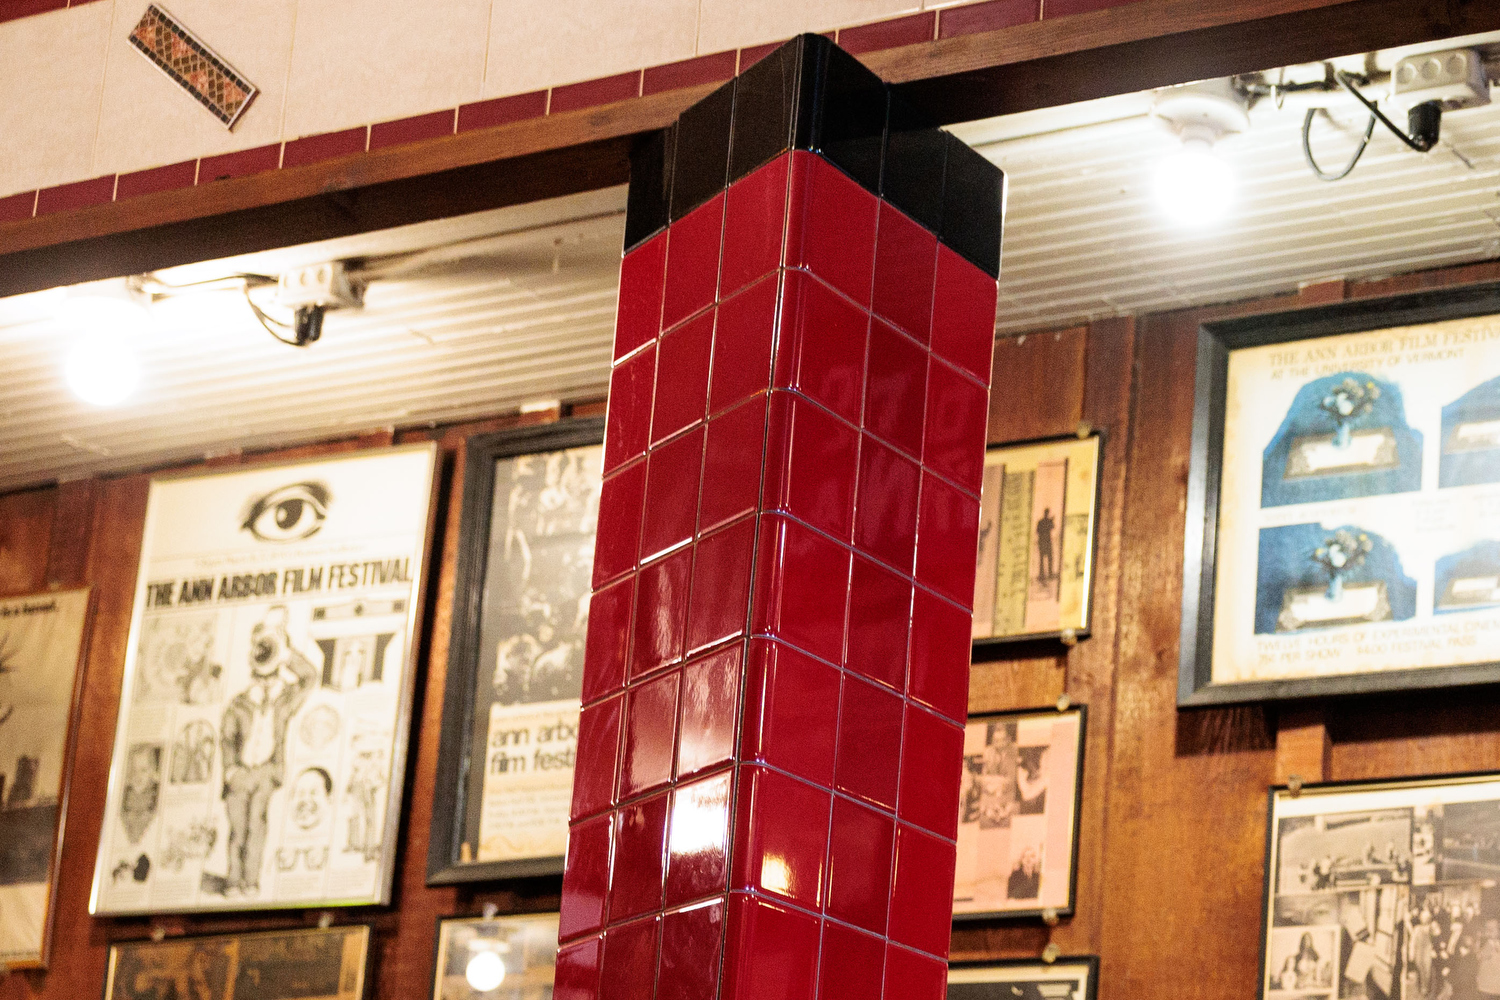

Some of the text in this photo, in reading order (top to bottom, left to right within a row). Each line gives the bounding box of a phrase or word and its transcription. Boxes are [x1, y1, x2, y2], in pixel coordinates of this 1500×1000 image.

[1399, 332, 1438, 353] FILM
[147, 556, 412, 608] THE ANN ARBOR FILM FESTIVAL
[492, 726, 530, 748] ann
[491, 751, 527, 775] film
